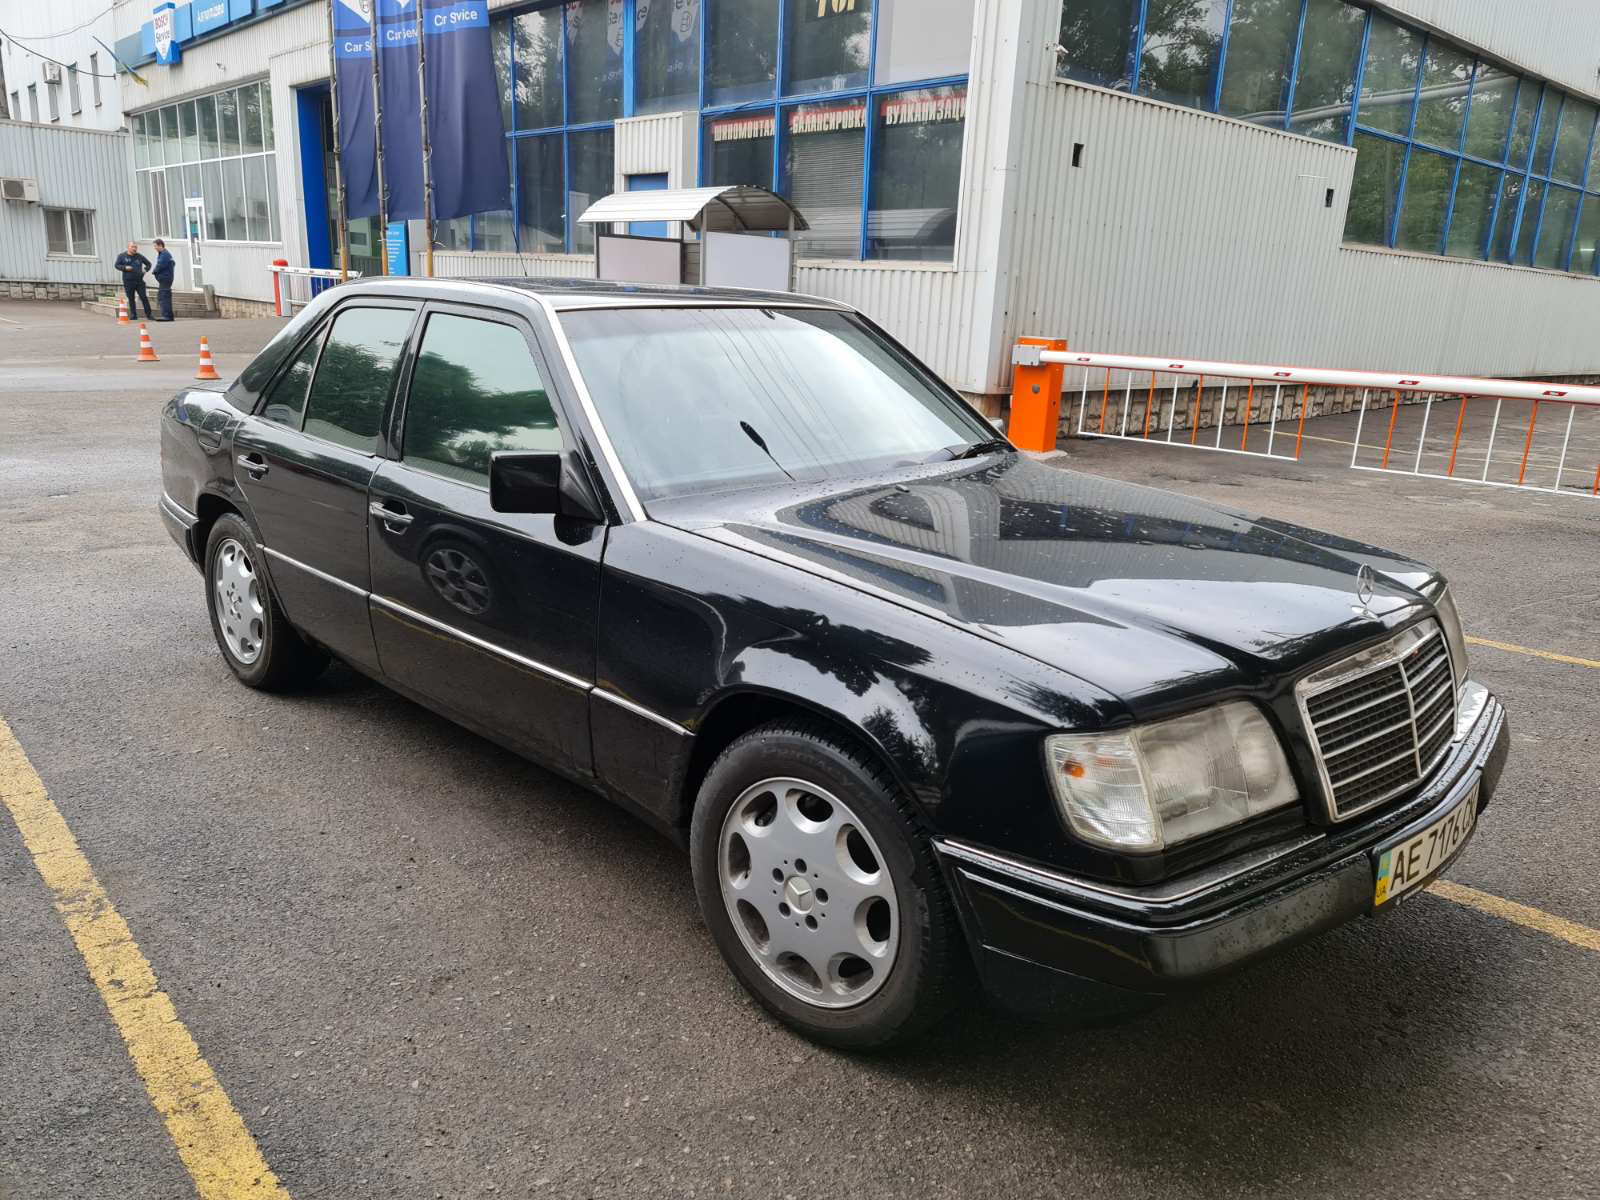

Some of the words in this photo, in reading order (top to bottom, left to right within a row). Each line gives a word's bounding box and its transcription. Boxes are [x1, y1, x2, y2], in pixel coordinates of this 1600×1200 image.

[344, 41, 363, 53] Car
[1390, 839, 1423, 891] AE
[1426, 807, 1462, 870] 7176
